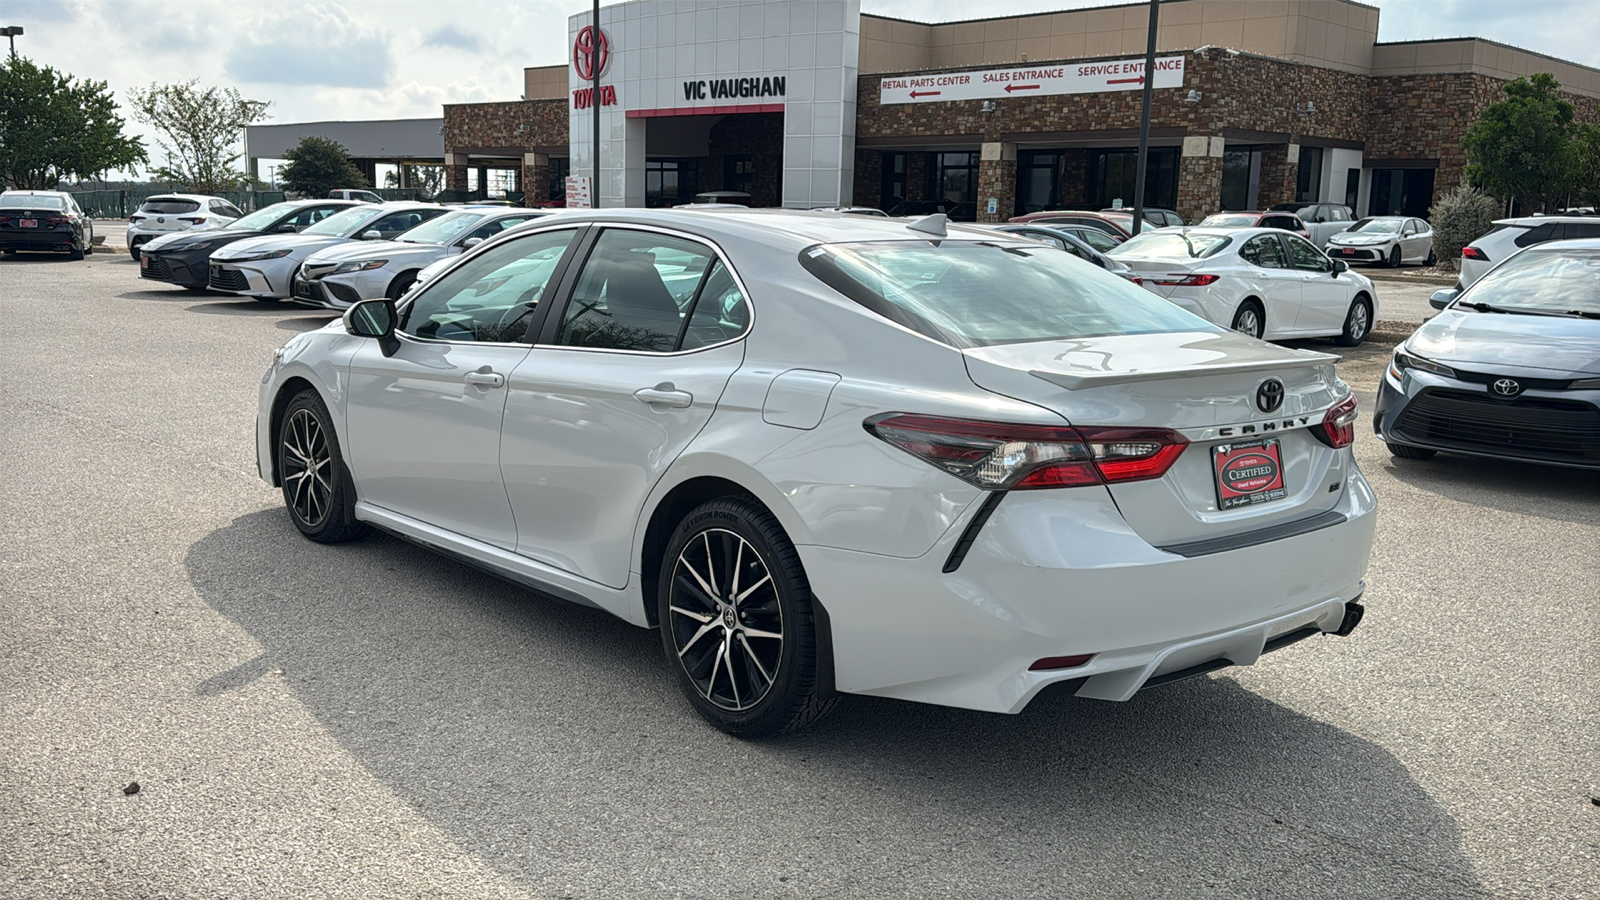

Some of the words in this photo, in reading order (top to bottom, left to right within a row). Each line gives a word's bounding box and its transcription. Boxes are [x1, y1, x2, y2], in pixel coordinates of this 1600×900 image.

[982, 71, 1010, 83] SALES
[1012, 68, 1064, 81] ENTRANCE
[1078, 64, 1120, 77] SERVICE
[683, 80, 706, 101] VIC
[709, 76, 786, 99] VAUGHAN
[882, 79, 908, 90] RETAIL
[910, 78, 935, 88] PARTS
[937, 75, 971, 86] CENTER
[1219, 416, 1310, 437] CAMRY
